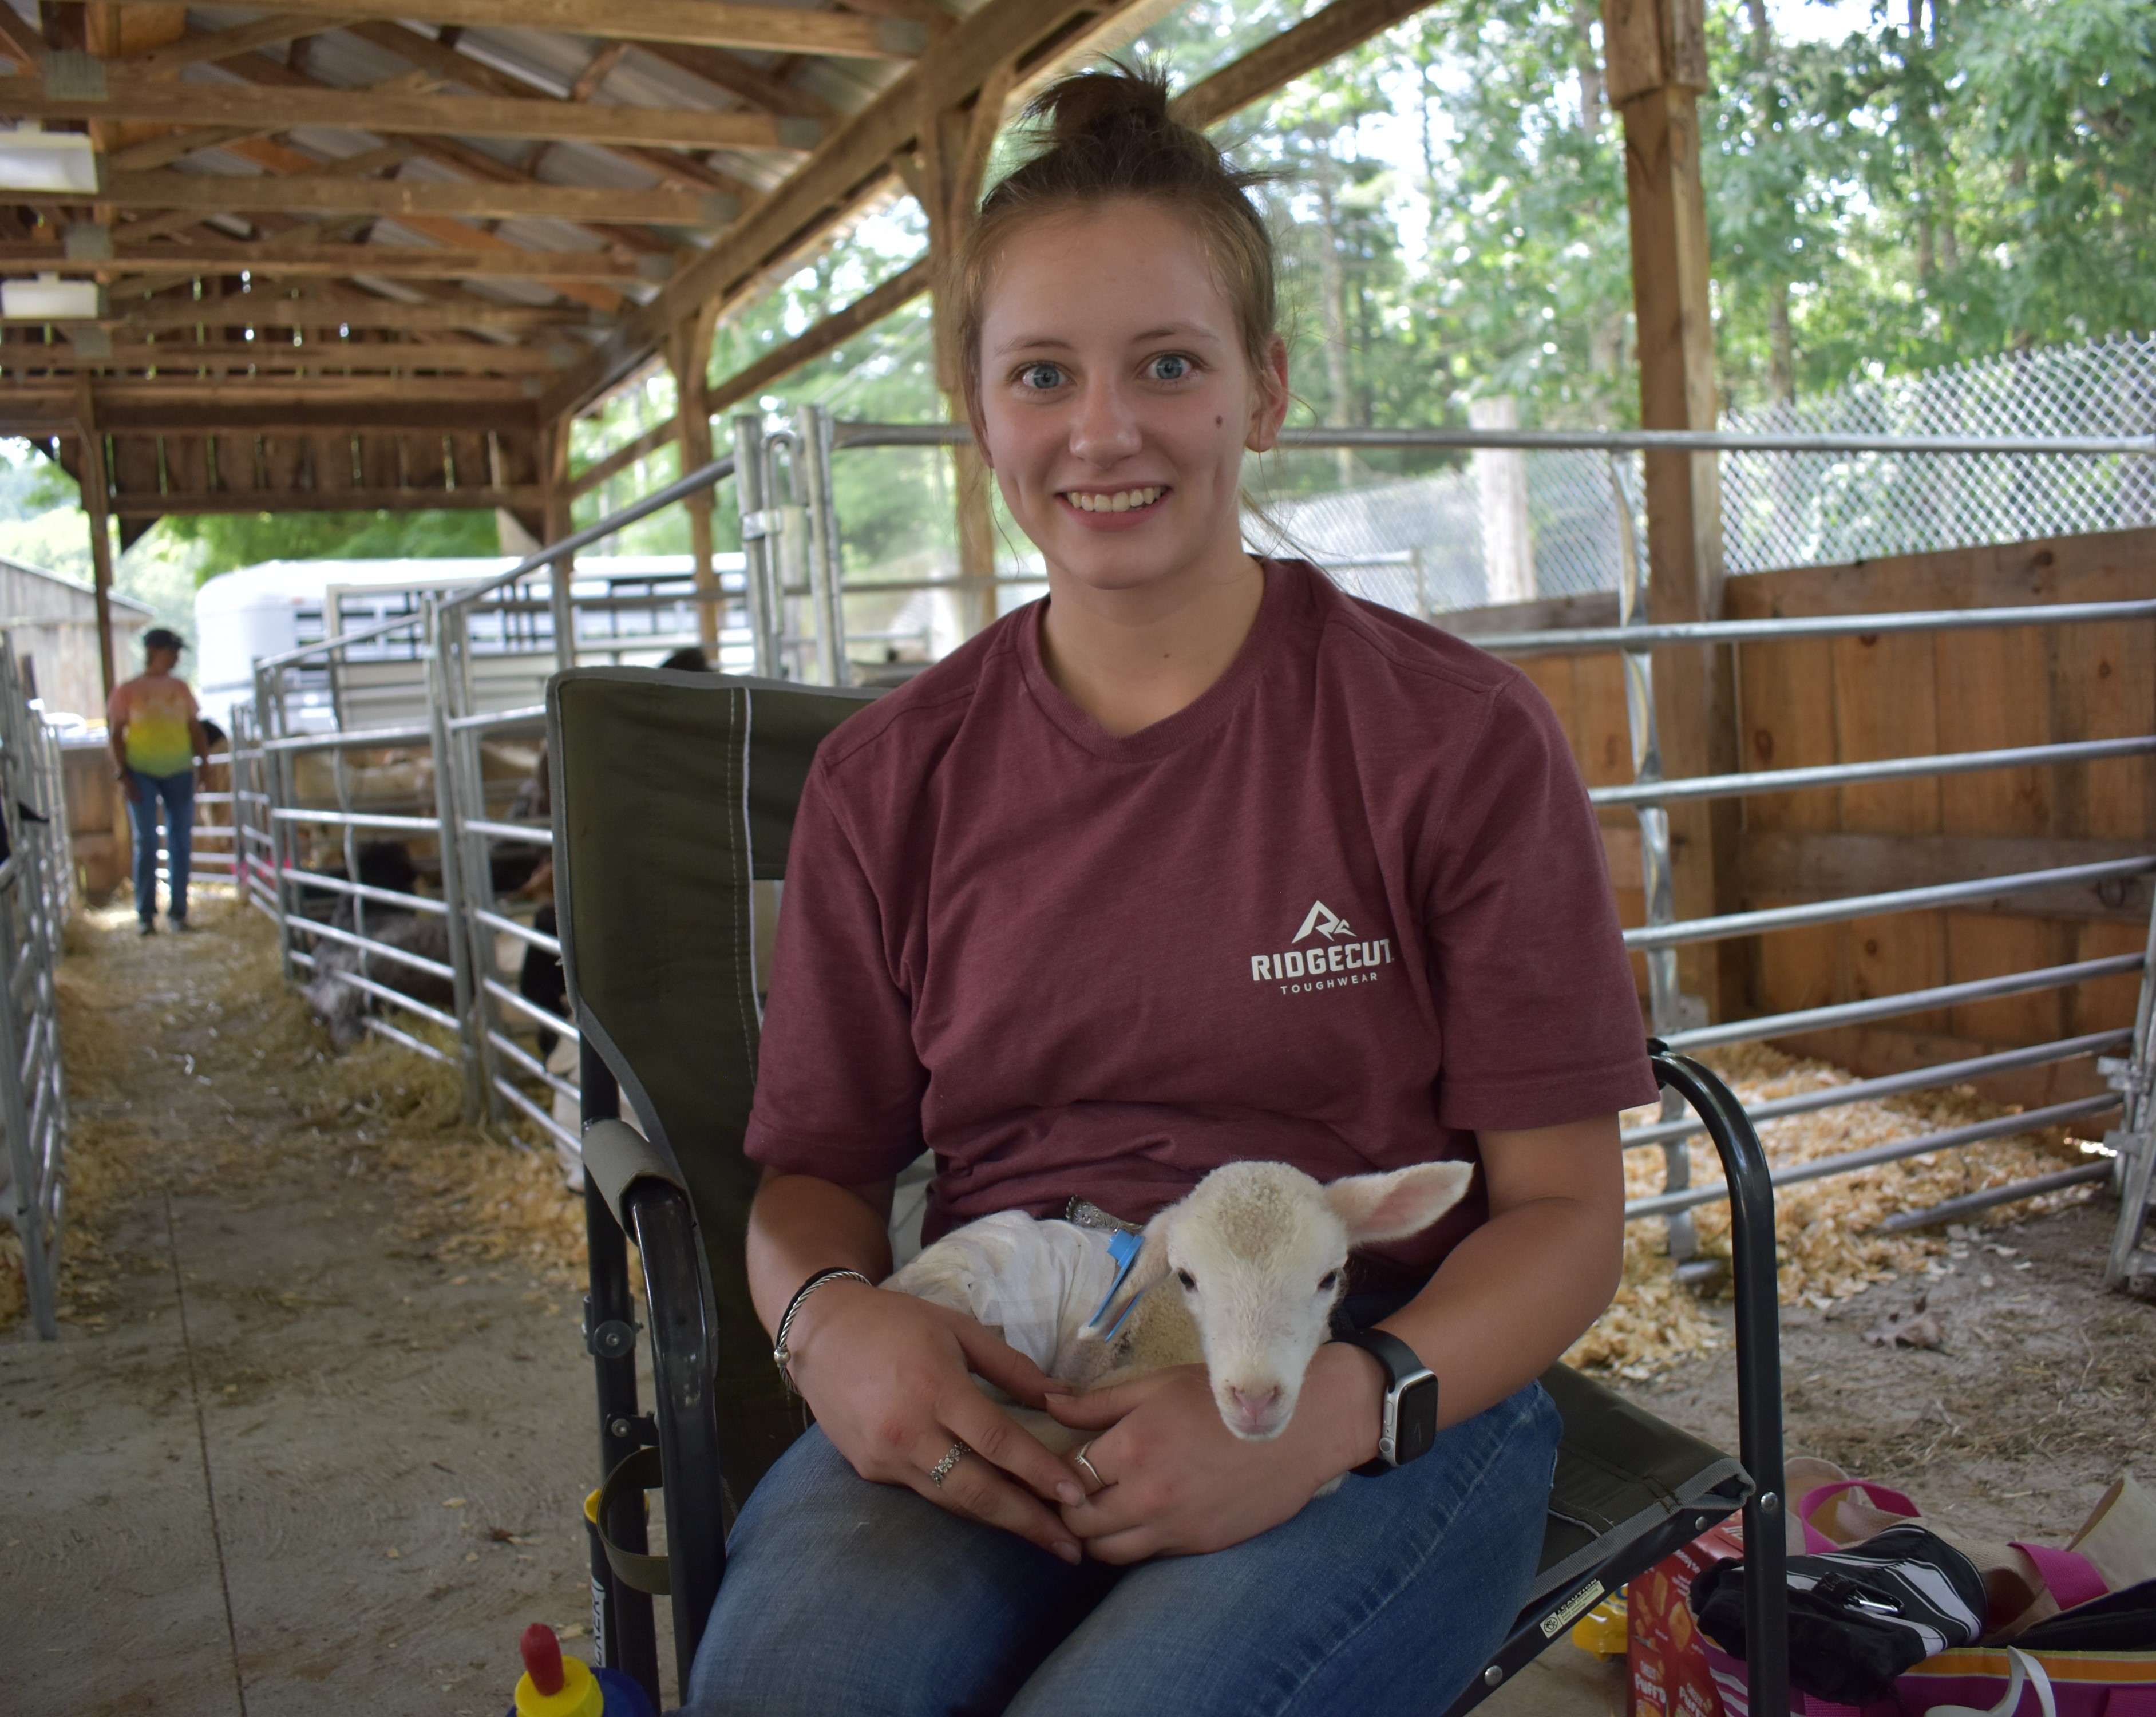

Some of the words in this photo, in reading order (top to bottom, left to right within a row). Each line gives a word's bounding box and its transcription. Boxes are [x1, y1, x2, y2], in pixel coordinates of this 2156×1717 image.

[1251, 939, 1391, 981] RIDGECUT
[1280, 972, 1378, 995] TOUGHWEAR
[1561, 1578, 1597, 1610] CAUTION
[1571, 1601, 1583, 1611] when
[1581, 1587, 1599, 1603] opening
[1560, 1608, 1567, 1616] DO
[1567, 1601, 1576, 1609] NOT
